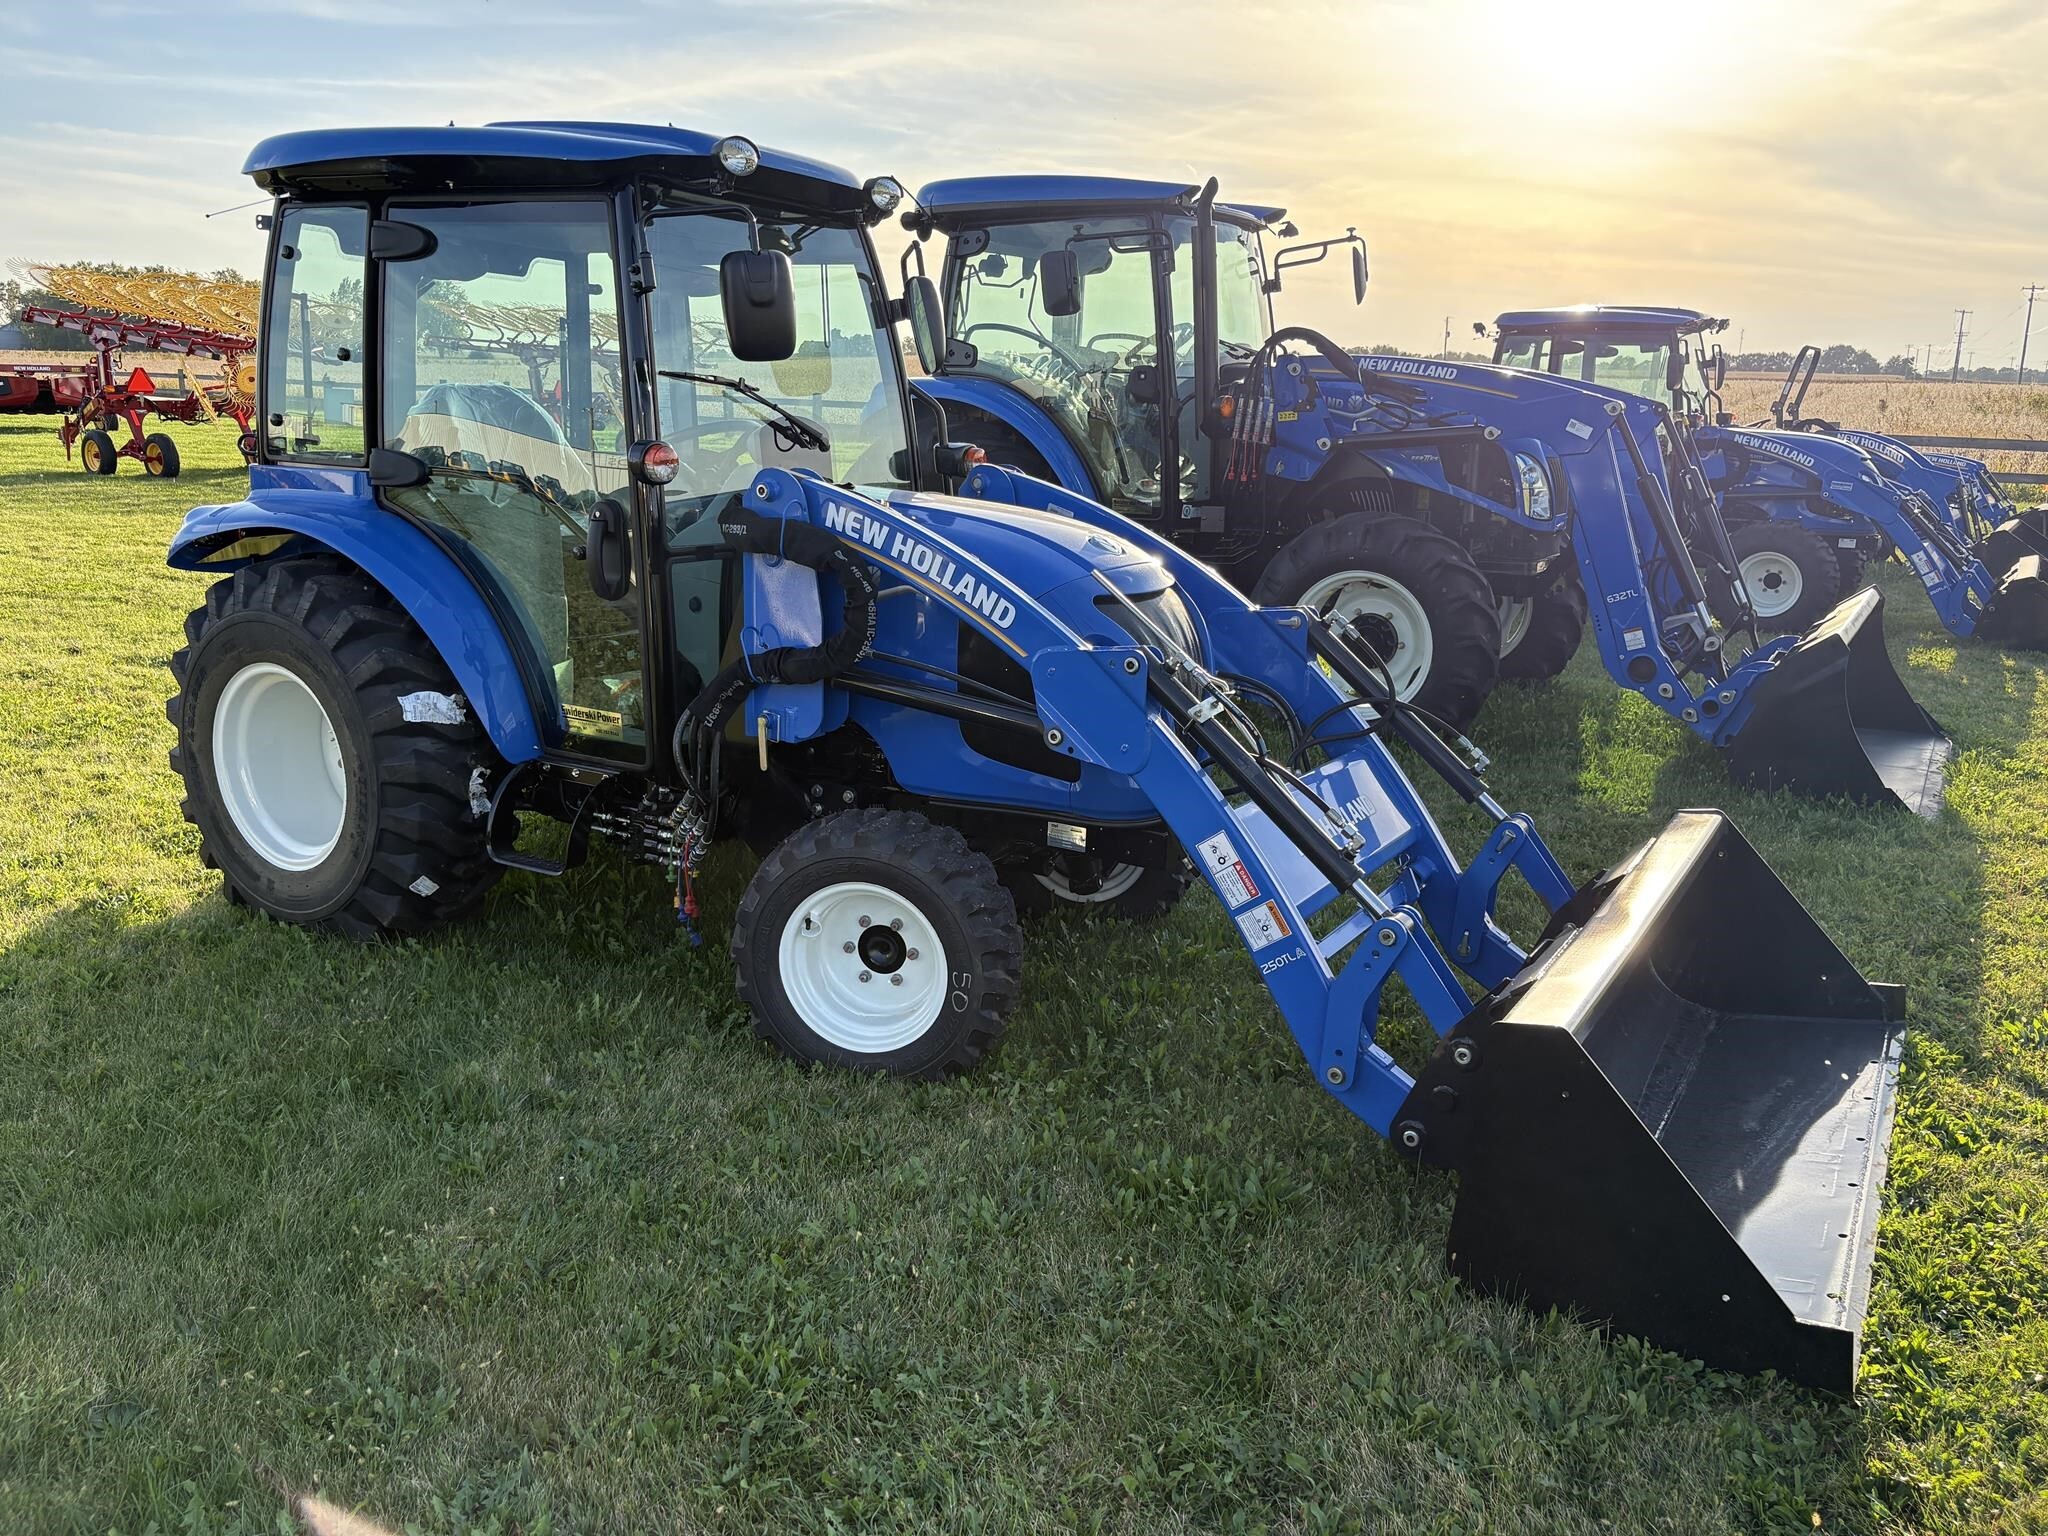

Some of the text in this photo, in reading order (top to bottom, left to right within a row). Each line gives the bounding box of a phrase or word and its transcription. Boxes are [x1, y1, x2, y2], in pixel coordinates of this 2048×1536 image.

[1359, 358, 1457, 380] NEW HOLLAND
[1734, 434, 1815, 467] NEW HOLLAND
[825, 502, 1016, 629] NEW HOLLAND
[1607, 590, 1638, 603] 632TL
[597, 711, 620, 724] Power
[1239, 870, 1256, 895] DANGER
[1261, 947, 1306, 974] 250TLA
[952, 971, 972, 1012] 50
